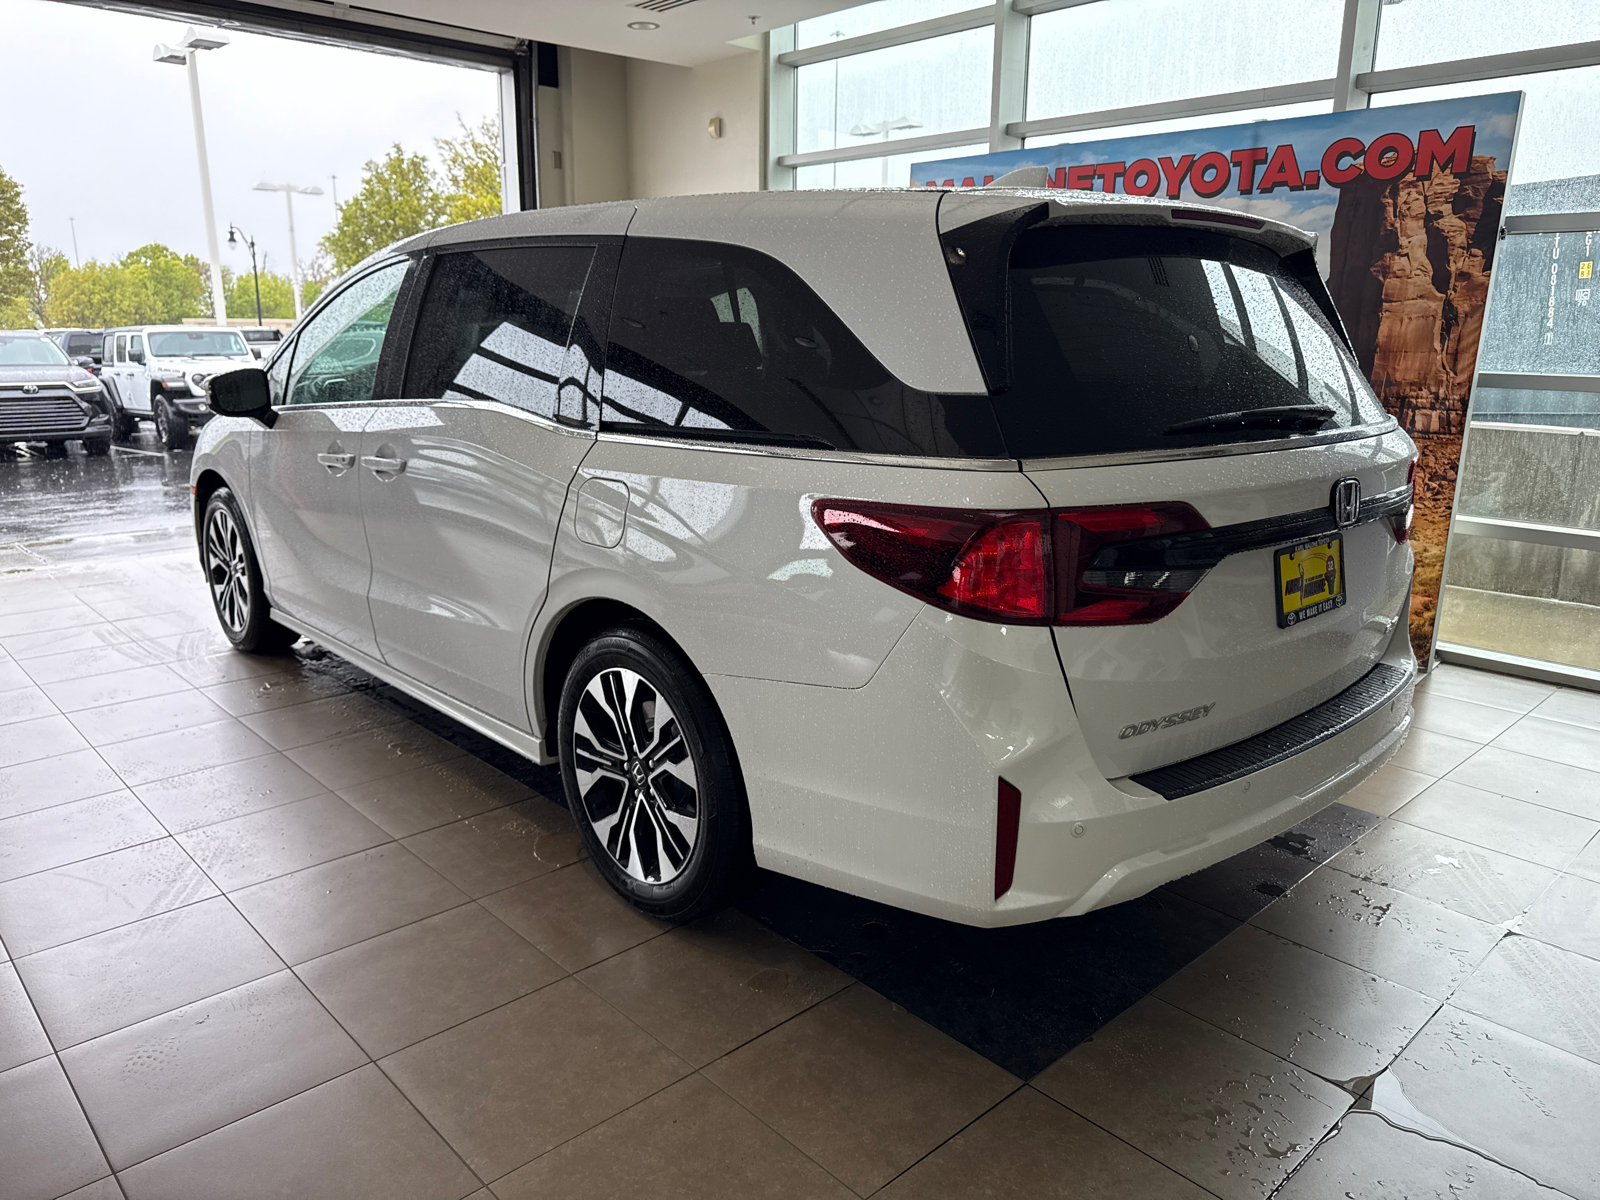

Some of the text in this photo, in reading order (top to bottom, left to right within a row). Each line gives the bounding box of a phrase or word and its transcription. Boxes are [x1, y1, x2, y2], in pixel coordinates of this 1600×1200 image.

[926, 125, 1477, 198] NETOYOTA.COM
[1322, 599, 1333, 611] EASY
[1117, 701, 1216, 739] ODYSSEY
